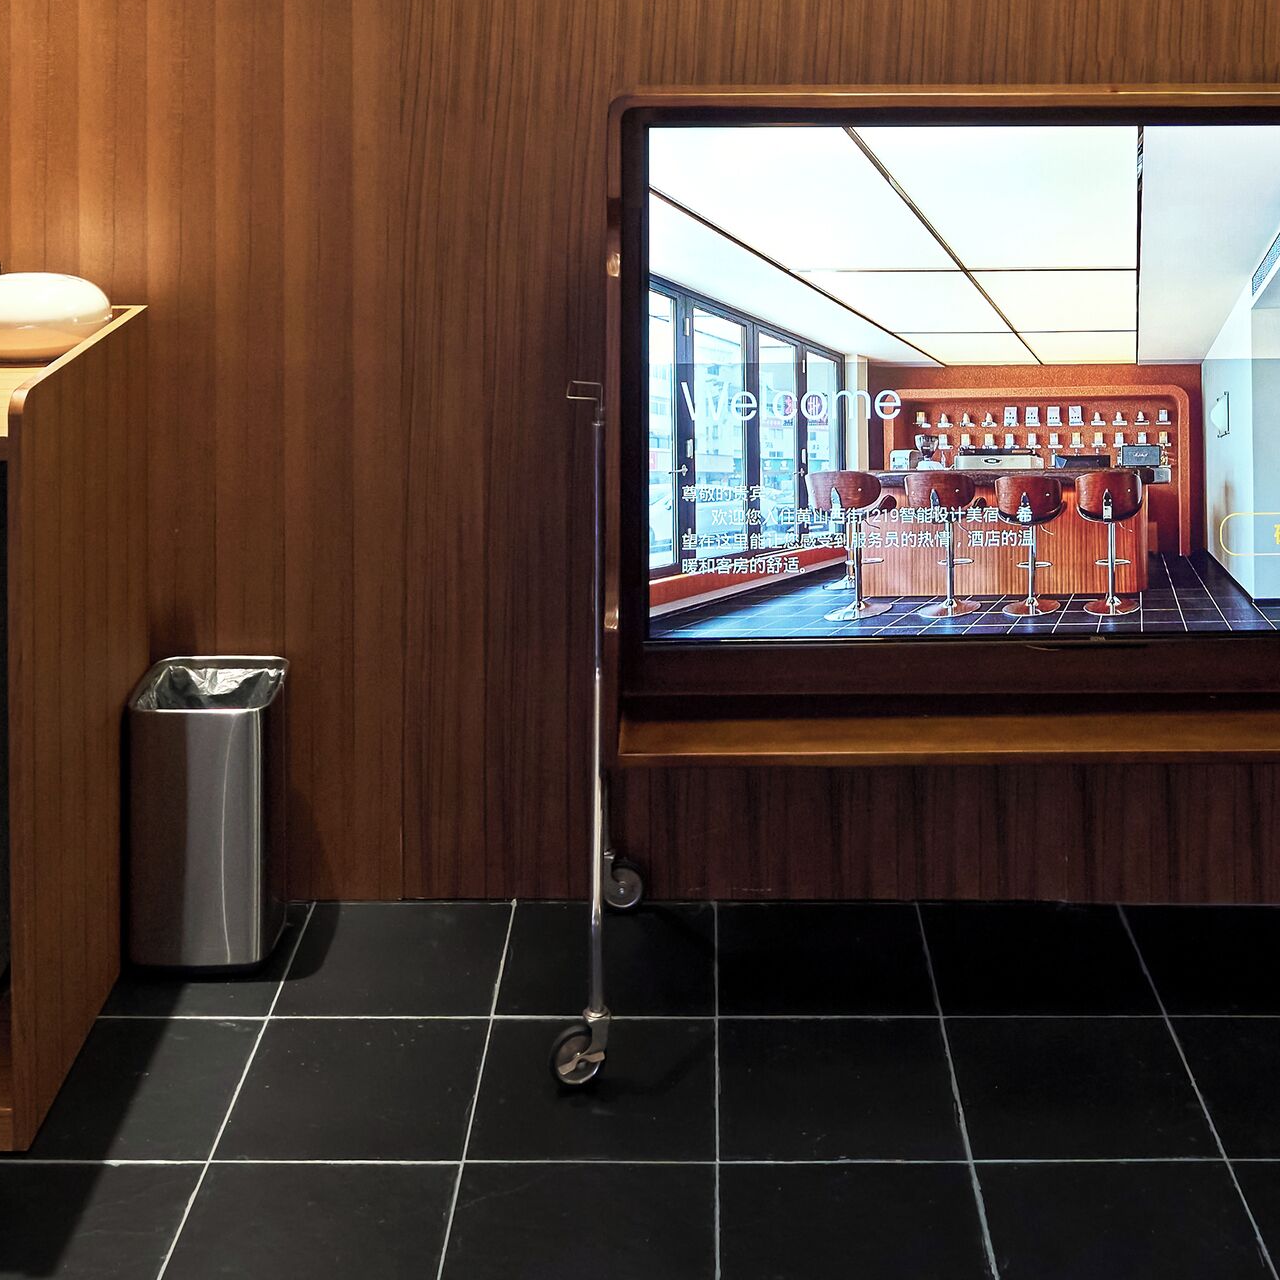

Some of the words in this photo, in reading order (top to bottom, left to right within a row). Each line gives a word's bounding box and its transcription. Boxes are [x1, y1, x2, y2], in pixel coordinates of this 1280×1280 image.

[681, 557, 807, 575] 暖和客房的舒适。
